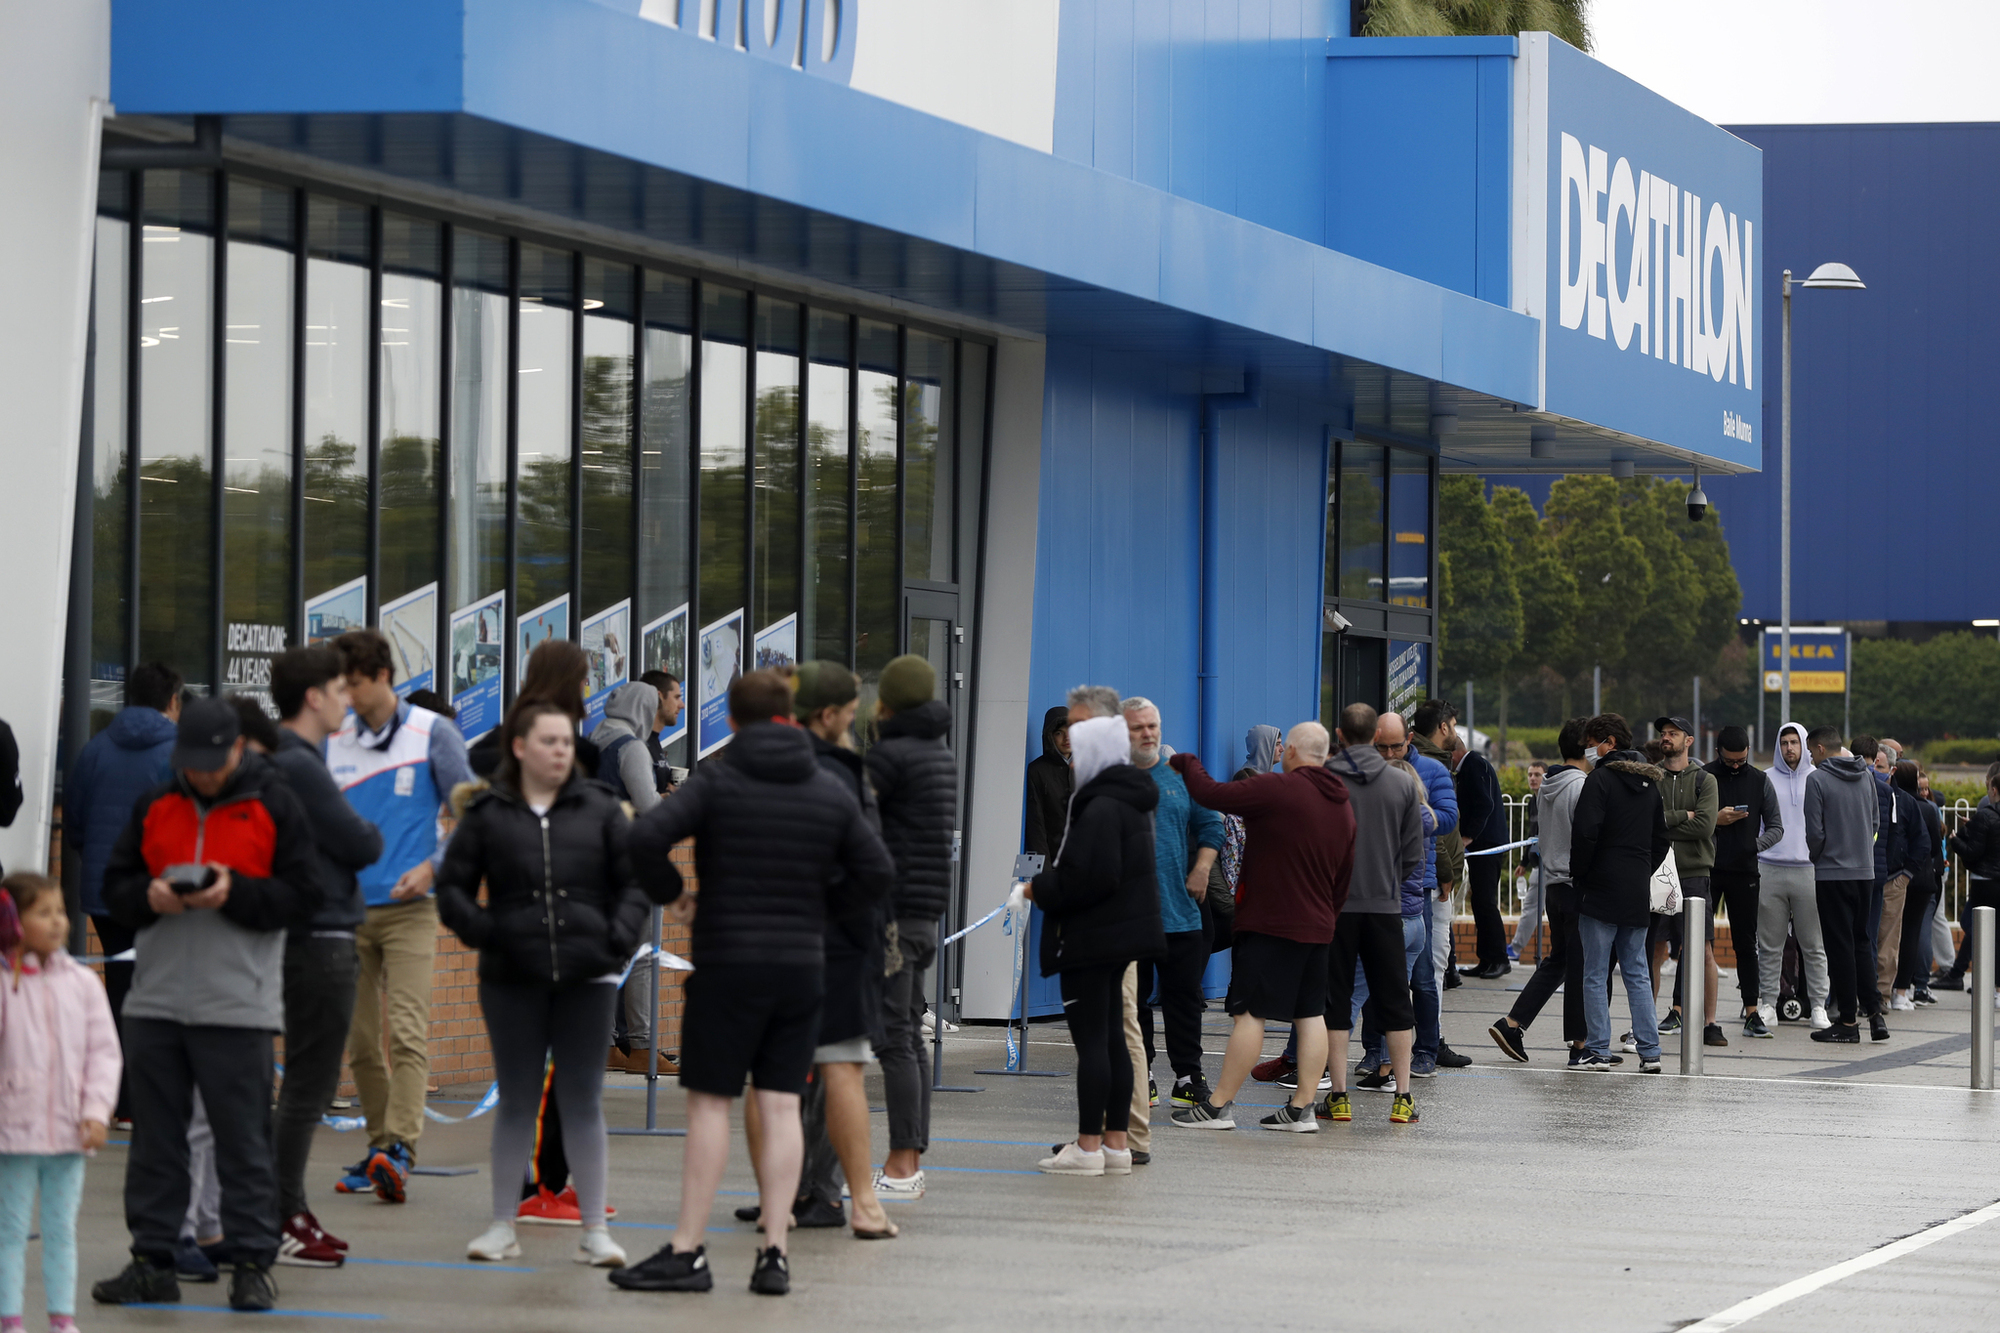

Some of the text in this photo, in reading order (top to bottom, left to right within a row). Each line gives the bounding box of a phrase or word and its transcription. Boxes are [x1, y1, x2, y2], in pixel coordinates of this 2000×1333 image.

[1560, 131, 1752, 390] DECATHLON
[1723, 410, 1752, 443] Baile Munna
[1772, 644, 1835, 658] IKEA
[227, 657, 273, 686] 44 YEARS
